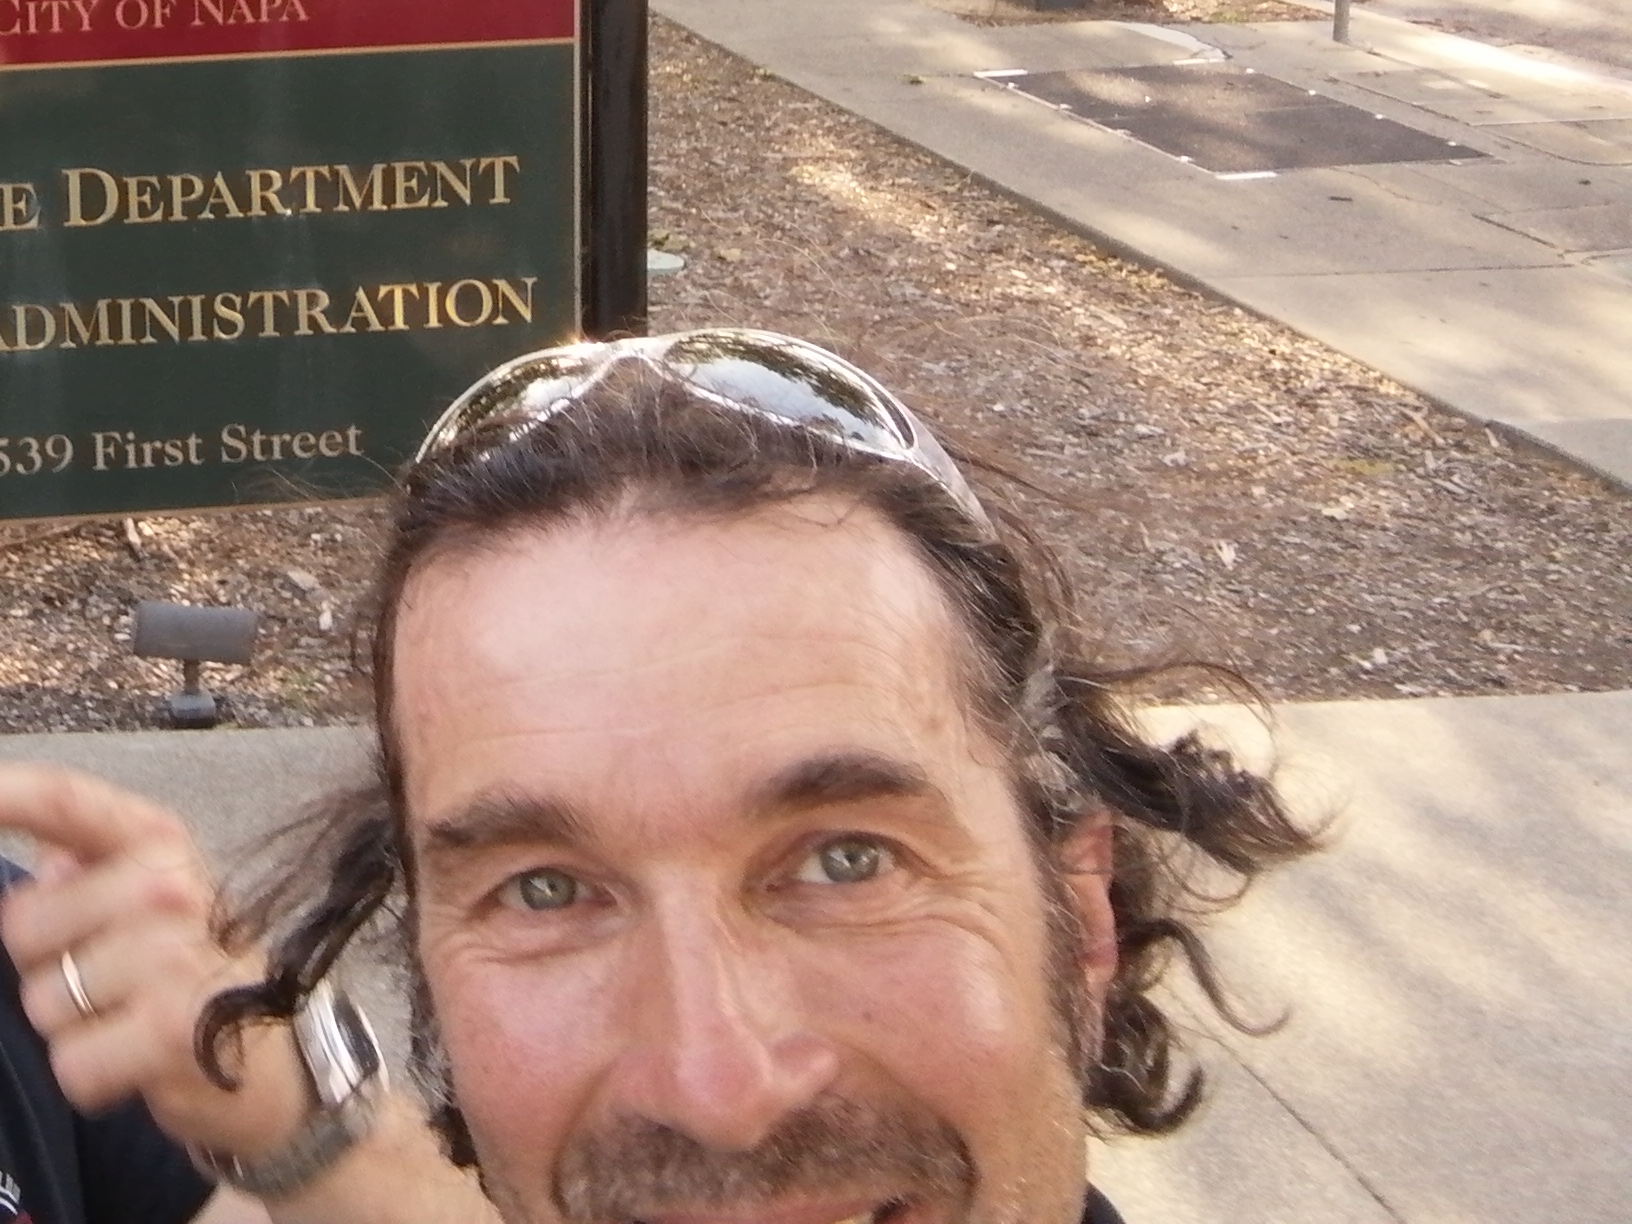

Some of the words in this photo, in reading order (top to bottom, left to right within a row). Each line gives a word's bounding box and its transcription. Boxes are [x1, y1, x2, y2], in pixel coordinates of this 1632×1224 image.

[61, 154, 521, 229] DEPARTMENT
[91, 429, 205, 472] First
[220, 422, 366, 464] Street
